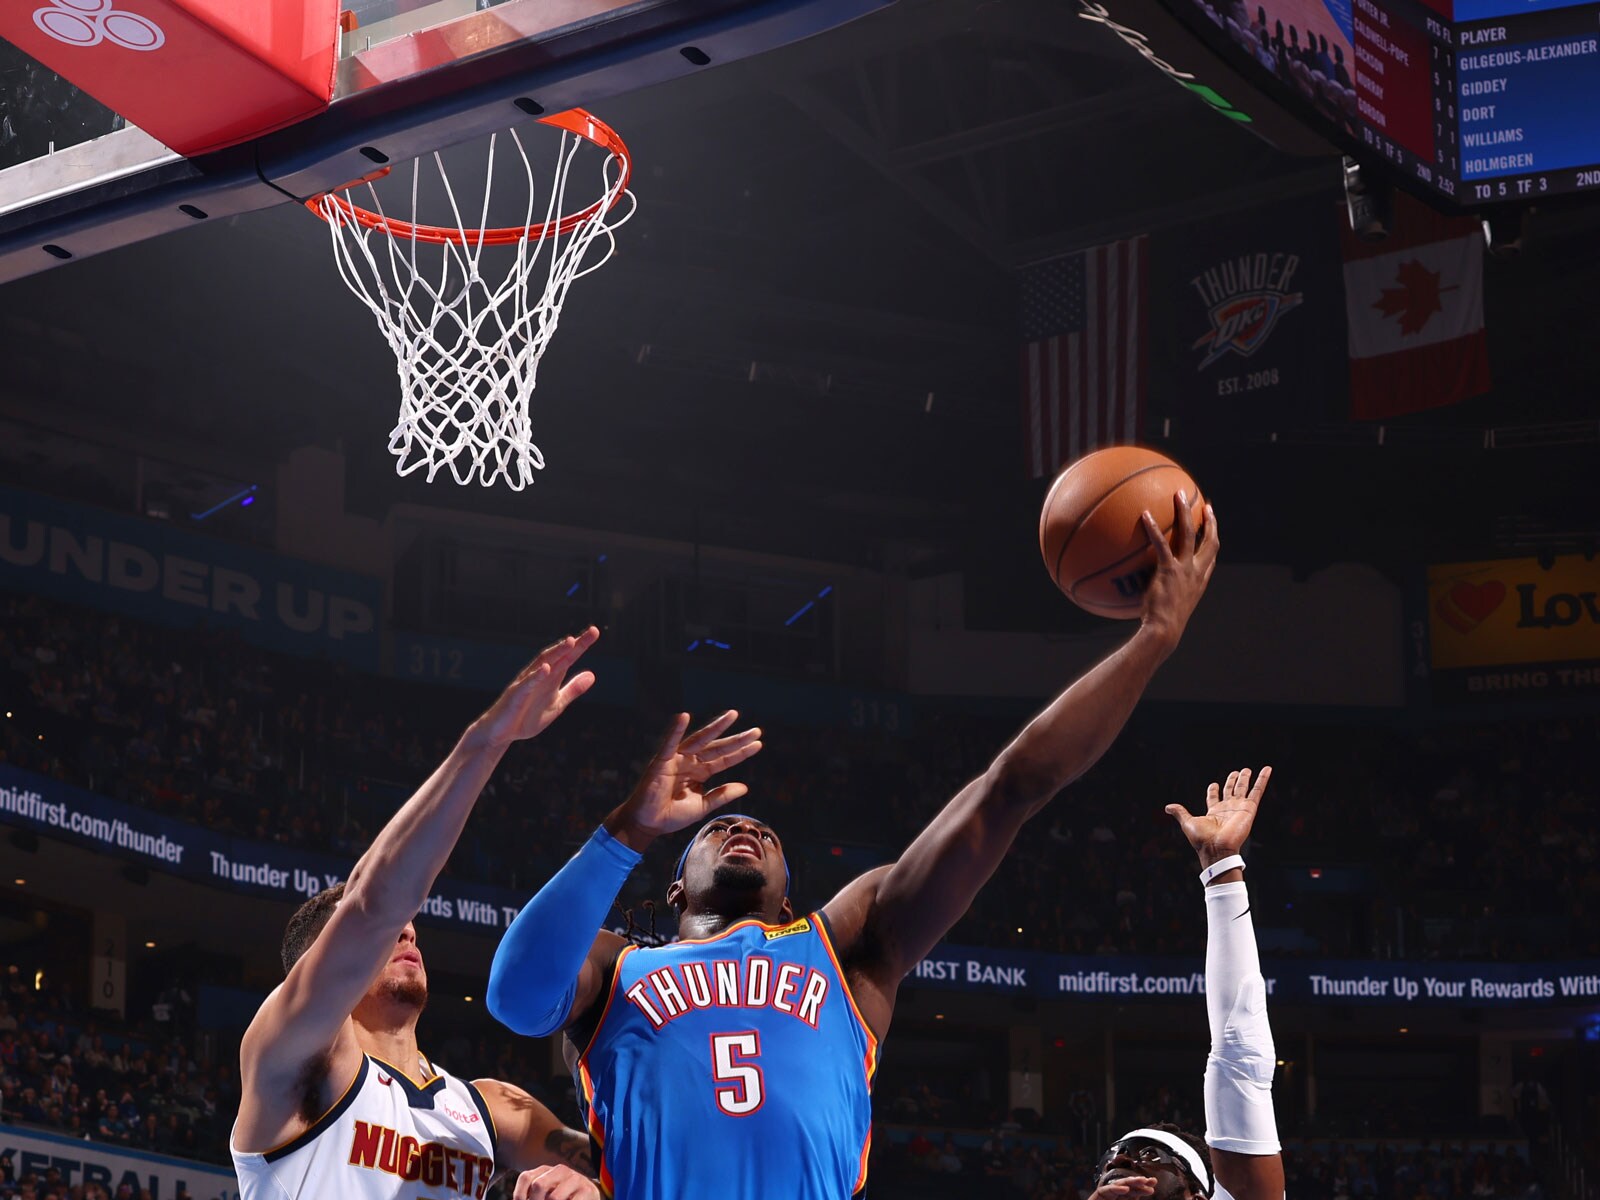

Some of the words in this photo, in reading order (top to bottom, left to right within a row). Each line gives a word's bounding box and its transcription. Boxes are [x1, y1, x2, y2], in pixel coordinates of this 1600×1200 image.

[1426, 16, 1441, 37] PTS
[1442, 26, 1453, 44] FL
[1459, 26, 1507, 46] PLAYER
[1459, 39, 1598, 71] GILGEOUS-ALEXANDER
[1460, 77, 1508, 97] GIDDEY
[1462, 105, 1497, 123] DORT
[1462, 127, 1525, 148] WILLIAMS
[1464, 152, 1535, 174] HOLMGREN
[1474, 184, 1492, 199] TO
[1498, 182, 1508, 197] 5
[1516, 179, 1533, 195] TF
[1538, 177, 1548, 192] 3
[1190, 253, 1300, 308] THUNDER
[1217, 377, 1244, 395] EST.
[1246, 367, 1280, 390] 2008
[276, 580, 375, 641] UP
[408, 643, 464, 679] 312
[1466, 670, 1550, 692] BRING
[294, 869, 320, 898] Up
[457, 898, 498, 927] With
[914, 959, 960, 980] IRST
[966, 960, 1027, 988] BANK
[1309, 975, 1389, 996] Thunder
[1394, 976, 1418, 1000] Up
[1424, 977, 1465, 998] Your
[1471, 978, 1555, 999] Rewards
[624, 955, 831, 1031] THUNDER
[709, 1028, 766, 1117] 5
[348, 1119, 495, 1200] NUGGETS
